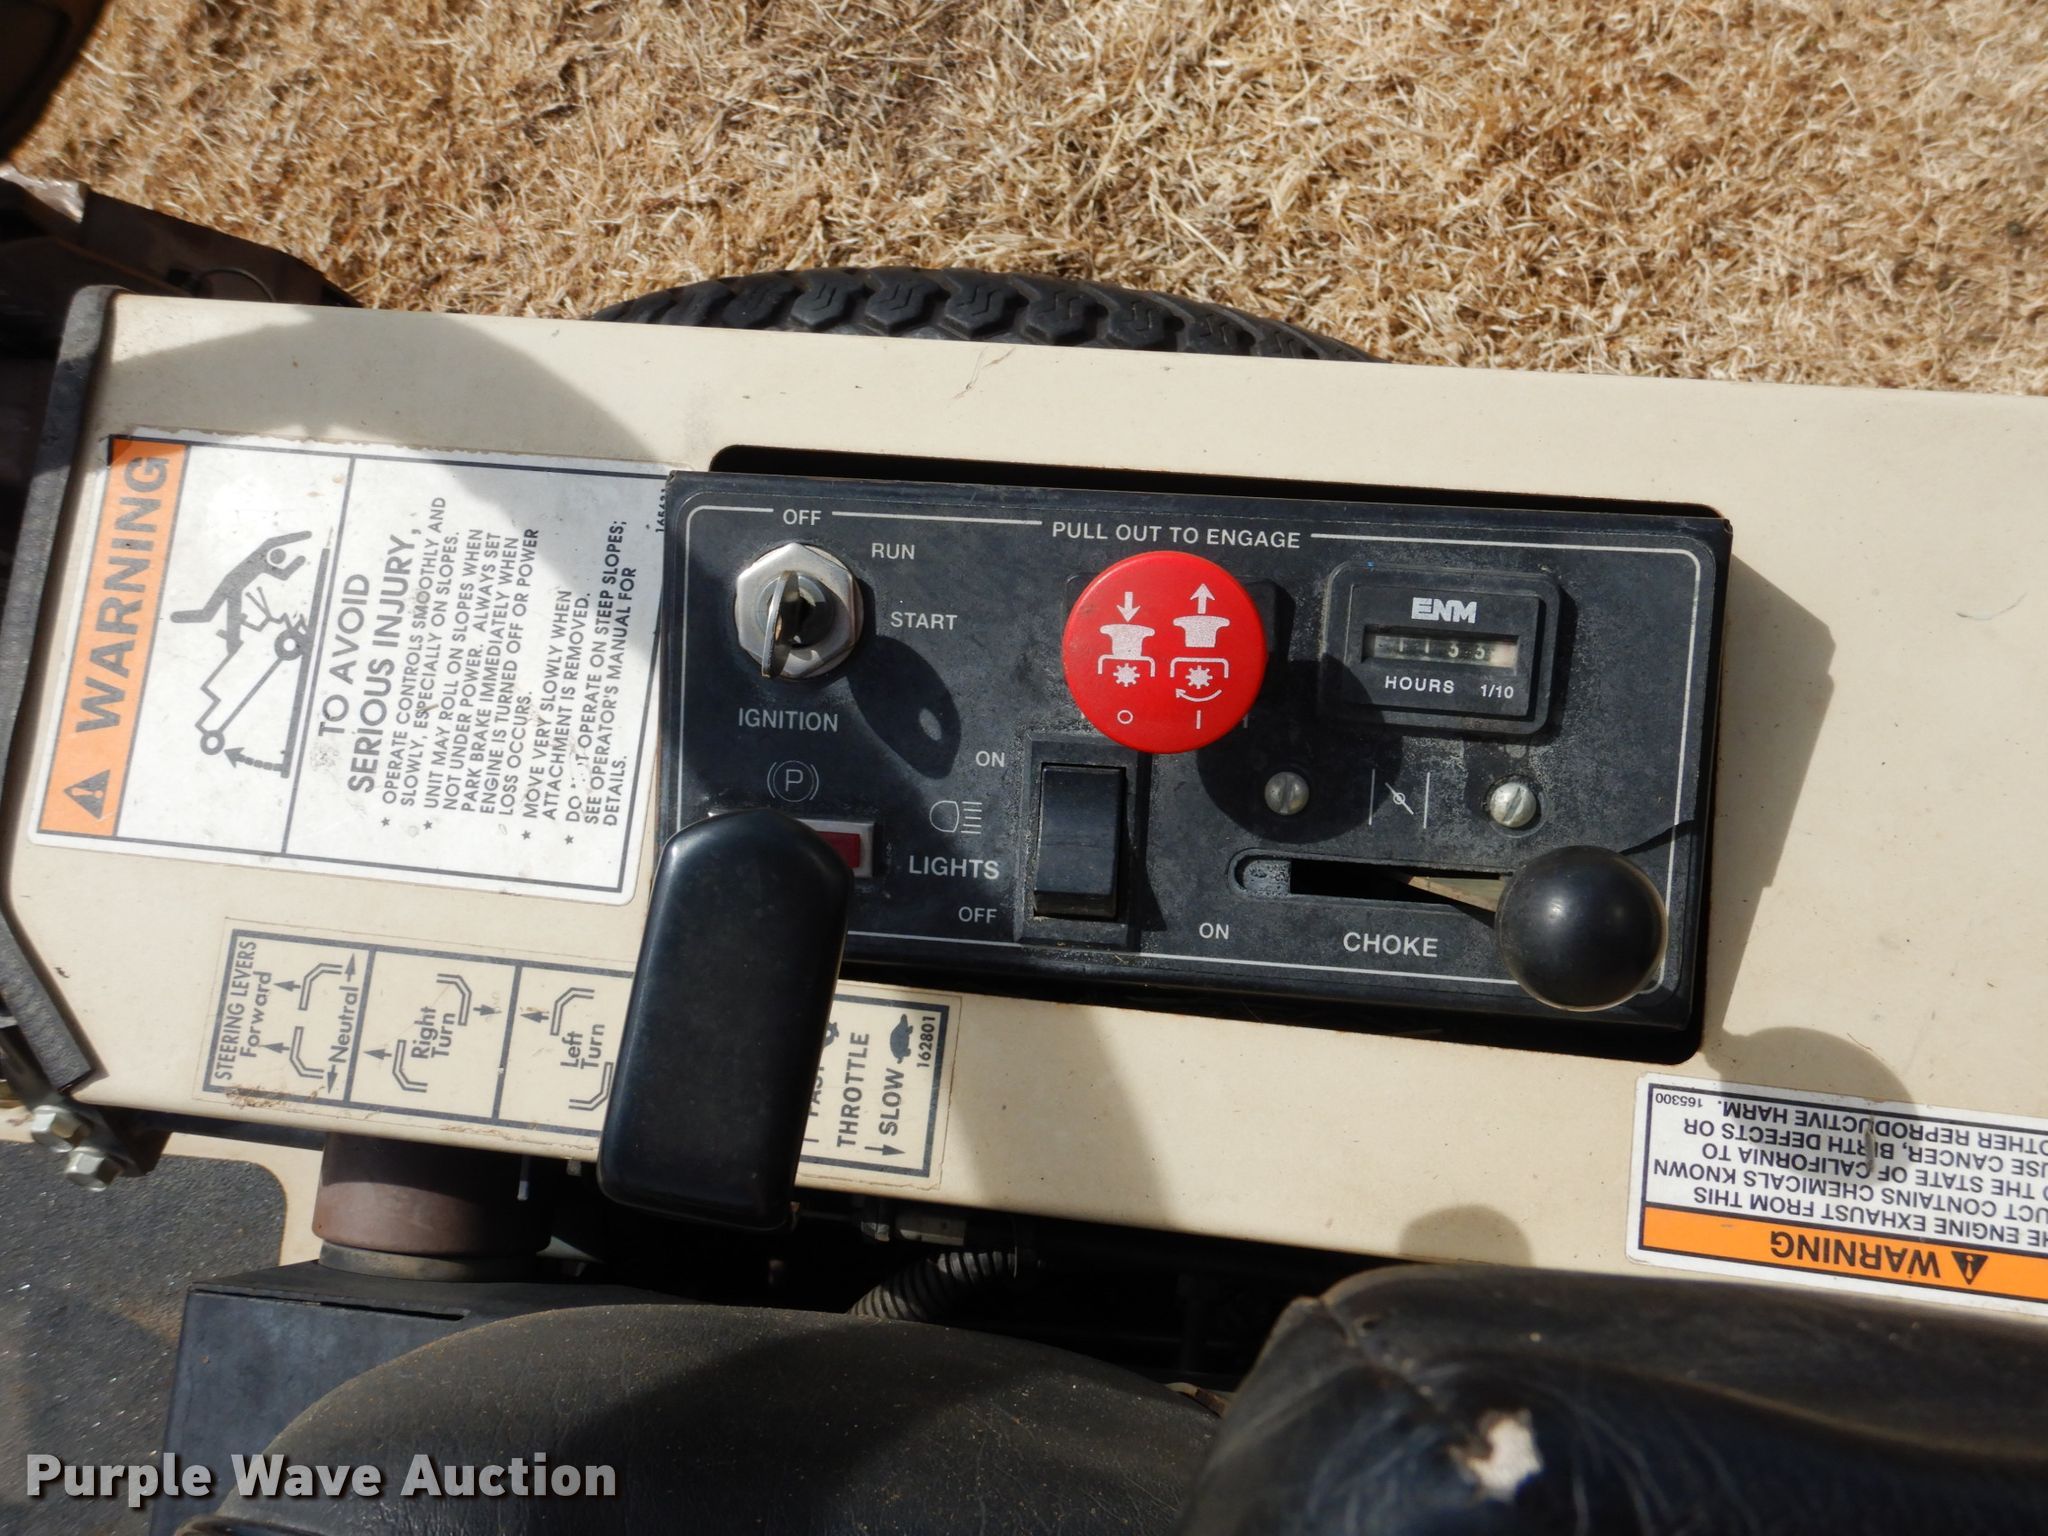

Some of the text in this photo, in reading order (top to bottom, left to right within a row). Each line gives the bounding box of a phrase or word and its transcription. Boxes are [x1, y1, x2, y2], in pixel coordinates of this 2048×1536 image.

[783, 509, 821, 526] OFF
[602, 519, 626, 584] SLOPES;
[871, 542, 916, 560] RUN
[1052, 522, 1301, 549] PULL OUT TO ENGAGE
[77, 456, 168, 731] WARNING
[595, 588, 615, 634] STEEP
[890, 611, 957, 630] START
[1411, 597, 1477, 624] ENM
[319, 573, 370, 736] TO AVOID
[349, 528, 418, 792] SERIOUS INJURY,
[383, 496, 446, 803] OPERATE CONTROLS SMOOTHLY AND
[590, 640, 607, 667] ON
[401, 531, 459, 806] SLOWLY, ESPECIALLY ON SLOPES.
[425, 528, 483, 808] UNIT MAY ROLL ON SLOPES WHEN
[444, 531, 501, 810] NOT UNDER POWER. ALWAYS SET
[463, 536, 519, 811] PARK BRAKE IMMEDIATELY WHEN
[482, 527, 539, 813] ENGINE IS TURNED OFF OR POWER
[585, 566, 637, 824] SEE OPERATOR'S MANUAL FOR
[1385, 675, 1514, 699] HOURS 1/10
[524, 589, 572, 818] MOVE VERY SLOWLY WHEN
[544, 592, 591, 819] ATTACHMENT IS REMOVED.
[578, 673, 602, 747] OPERATE
[738, 708, 839, 733] IGNITION
[500, 690, 532, 815] LOSS OCCURS.
[975, 750, 1005, 768] ON
[604, 755, 627, 826] DETAILS.
[566, 794, 583, 822] DO
[908, 856, 1000, 880] LIGHTS
[958, 906, 997, 924] OFF
[1199, 923, 1229, 940] ON
[1343, 931, 1439, 958] CHOKE
[214, 941, 257, 1080] STEERING LEVERS
[239, 971, 272, 1058] Forward
[328, 986, 359, 1064] Neutral
[410, 1006, 436, 1059] Right
[430, 1012, 456, 1058] Turn
[580, 1024, 605, 1070] Turn
[916, 1015, 936, 1068] 162801
[560, 1031, 583, 1068] Left
[836, 1032, 870, 1147] THROTTLE
[878, 1068, 905, 1137] SLOW
[1655, 1092, 1703, 1108] 165300
[1683, 1118, 1715, 1137] OR
[1718, 1100, 1788, 1125] HARM.
[1794, 1109, 1970, 1146] REPRODUCTIVE
[1701, 1142, 1732, 1162] TO
[1721, 1122, 1822, 1151] DEFECTS
[1653, 1158, 1736, 1185] KNOWN
[1738, 1147, 1872, 1179] CALIFORNIA
[1877, 1165, 1908, 1184] OF
[1902, 1144, 2004, 1173] CANCER,
[1743, 1170, 1874, 1202] CHEMICALS
[1915, 1169, 1984, 1193] STATE
[1991, 1178, 2035, 1200] THE
[1693, 1186, 1743, 1209] THIS
[1749, 1193, 1815, 1218] FROM
[1881, 1187, 1997, 1217] CONTAINS
[1821, 1203, 1926, 1232] EXHAUST
[1934, 1217, 2020, 1244] ENGINE
[1770, 1231, 1940, 1278] WARNING
